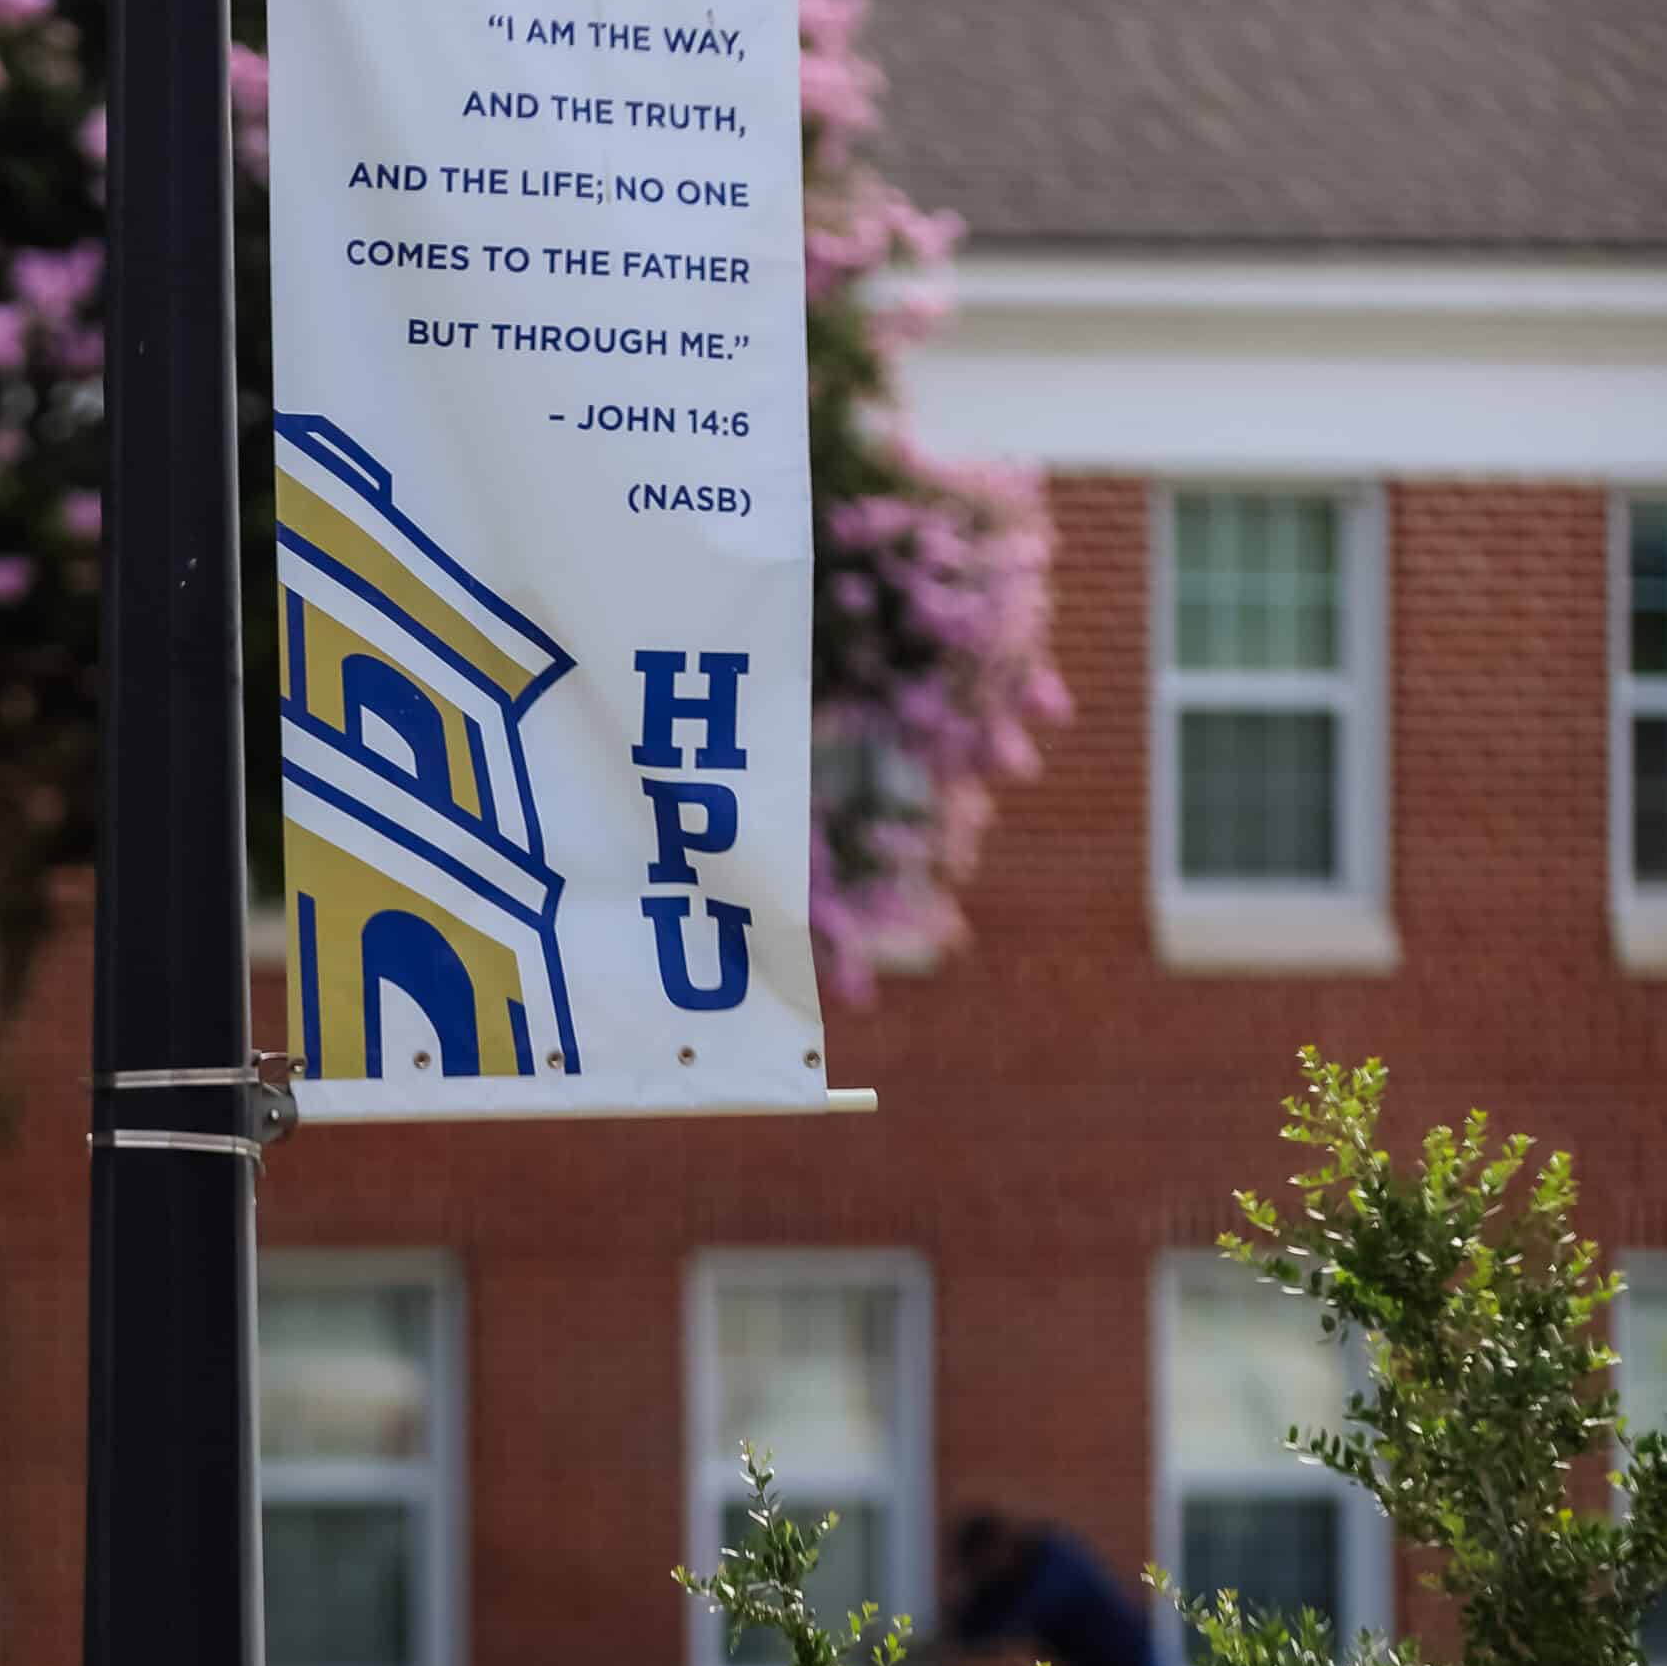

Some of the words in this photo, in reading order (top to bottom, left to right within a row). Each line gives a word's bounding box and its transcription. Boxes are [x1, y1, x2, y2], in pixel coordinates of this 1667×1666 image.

[489, 15, 513, 41] “I
[526, 19, 574, 45] AM
[588, 22, 650, 51] THE
[664, 27, 744, 61] WAY,
[462, 91, 539, 119] AND
[551, 95, 613, 125] THE
[625, 101, 745, 138] TRUTH,
[348, 162, 427, 191] AND
[440, 167, 508, 194] THE
[522, 170, 603, 205] LIFE;
[616, 176, 664, 203] NO
[677, 180, 750, 207] ONE
[347, 240, 469, 271] COMES
[482, 246, 530, 273] TO
[542, 248, 610, 276] THE
[623, 252, 749, 284] FATHER
[408, 319, 479, 348] BUT
[491, 324, 667, 355] THROUGH
[681, 332, 749, 360] ME.”
[577, 405, 675, 433] JOHN
[688, 409, 749, 437] 14:6
[628, 484, 751, 517] (NASB)
[631, 650, 753, 1012] HPU
